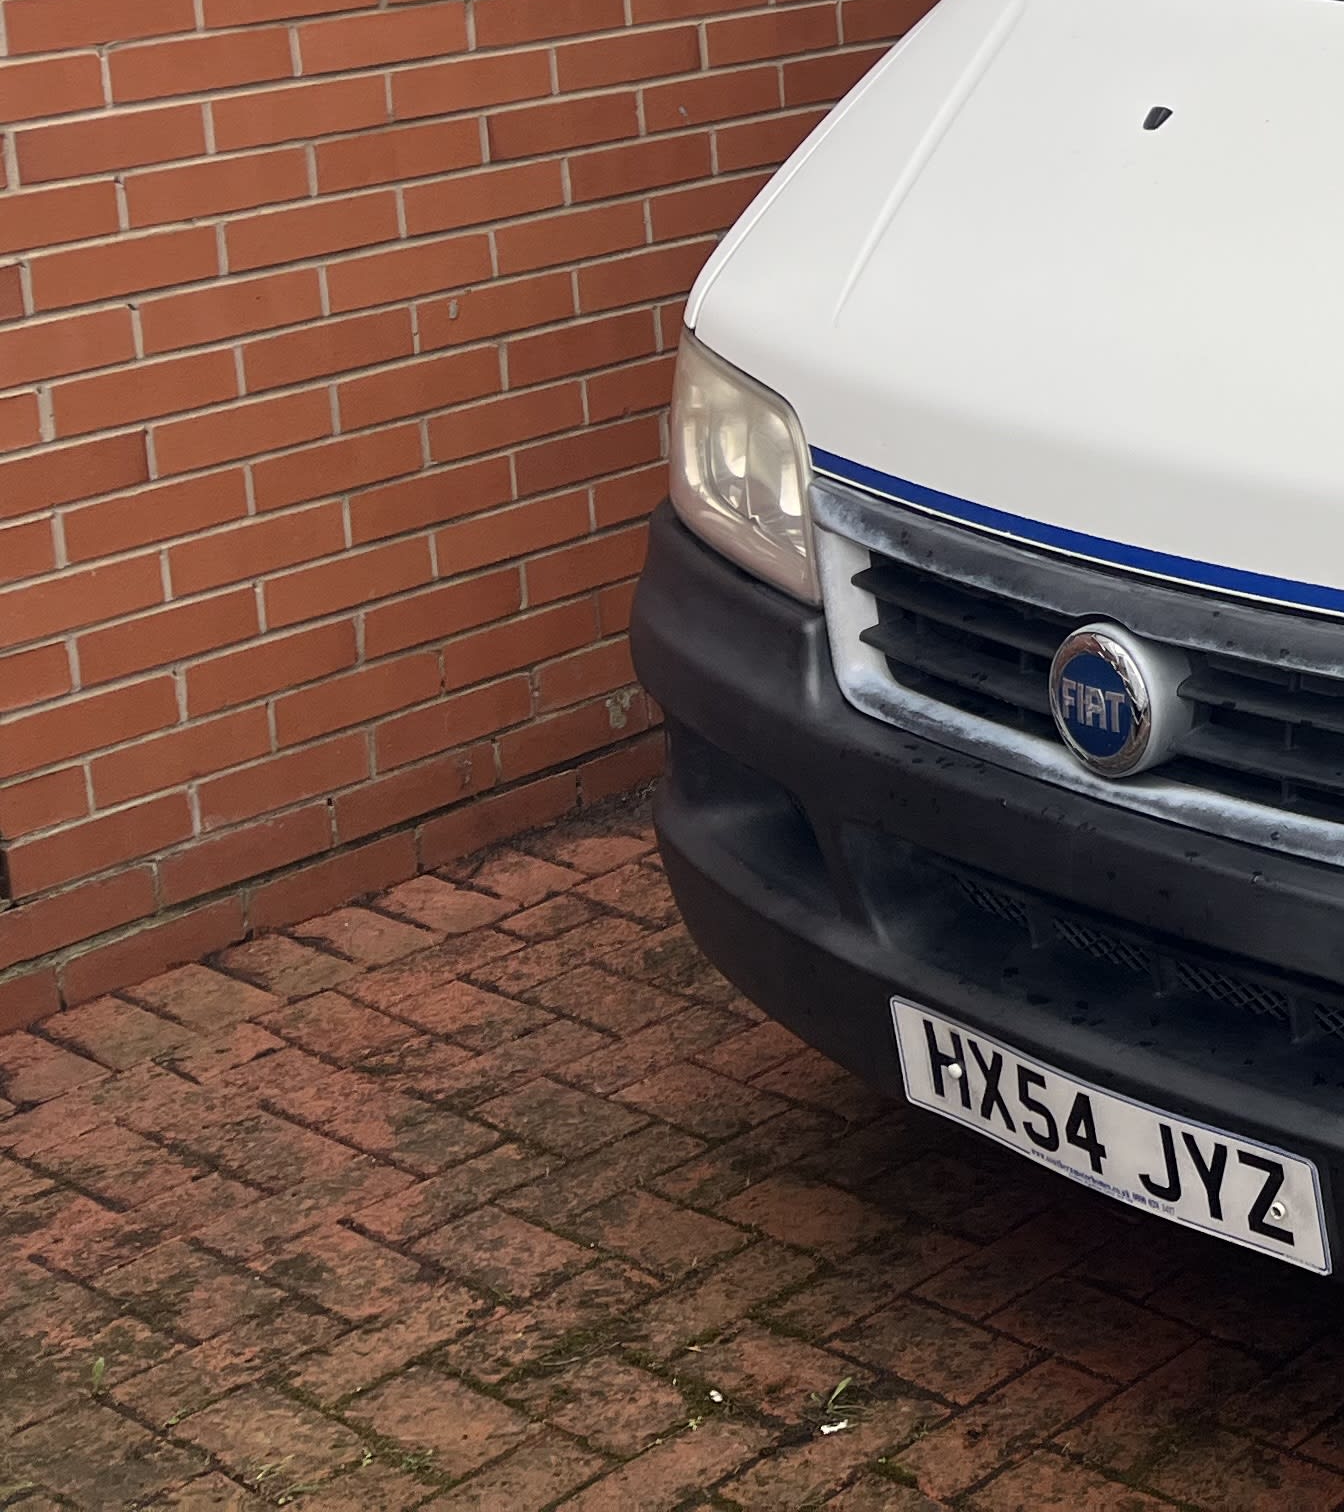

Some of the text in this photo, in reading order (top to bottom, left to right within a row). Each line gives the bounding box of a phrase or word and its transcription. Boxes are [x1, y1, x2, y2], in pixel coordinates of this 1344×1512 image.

[1061, 676, 1125, 733] FIAT
[922, 1019, 1107, 1176] HX54
[1138, 1123, 1296, 1248] JYZ
